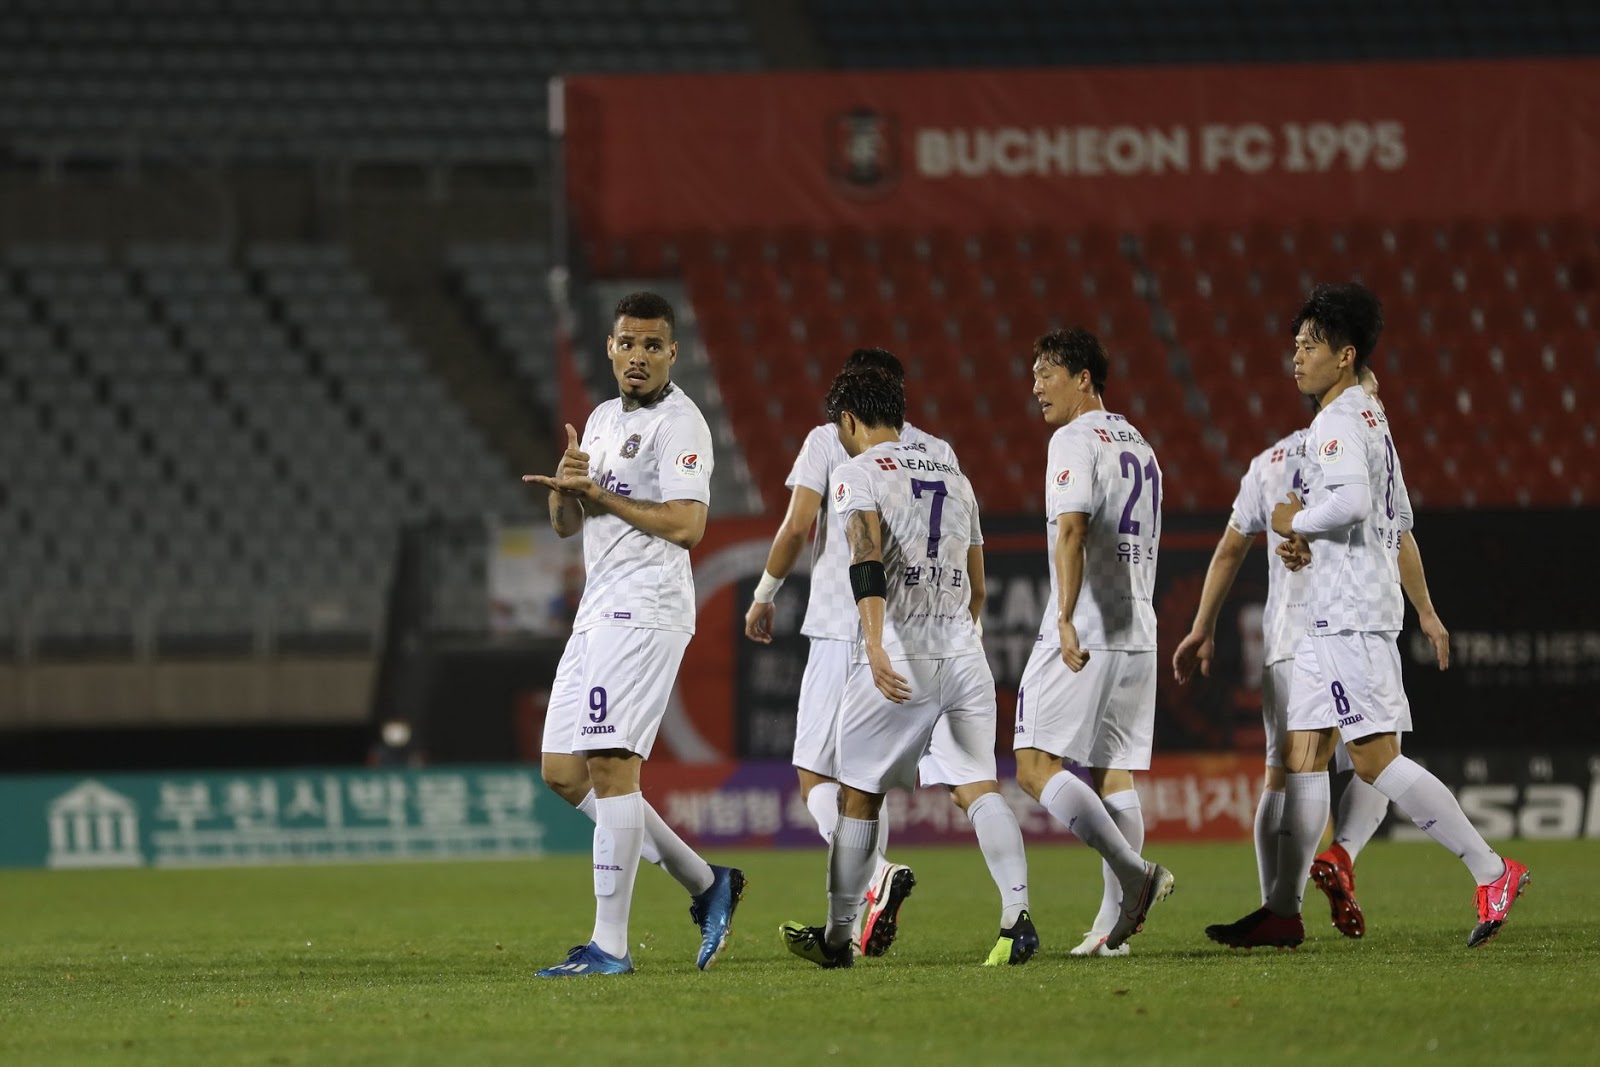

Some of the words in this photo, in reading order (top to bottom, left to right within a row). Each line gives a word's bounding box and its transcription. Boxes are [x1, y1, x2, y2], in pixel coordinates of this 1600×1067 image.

[917, 126, 1189, 177] BUCHEON
[1203, 123, 1273, 174] FC
[1283, 120, 1407, 172] 1995
[911, 477, 948, 558] 7
[1119, 451, 1160, 538] 21
[1410, 630, 1531, 664] UTRAS
[589, 686, 608, 723] 9
[1331, 680, 1351, 716] 8
